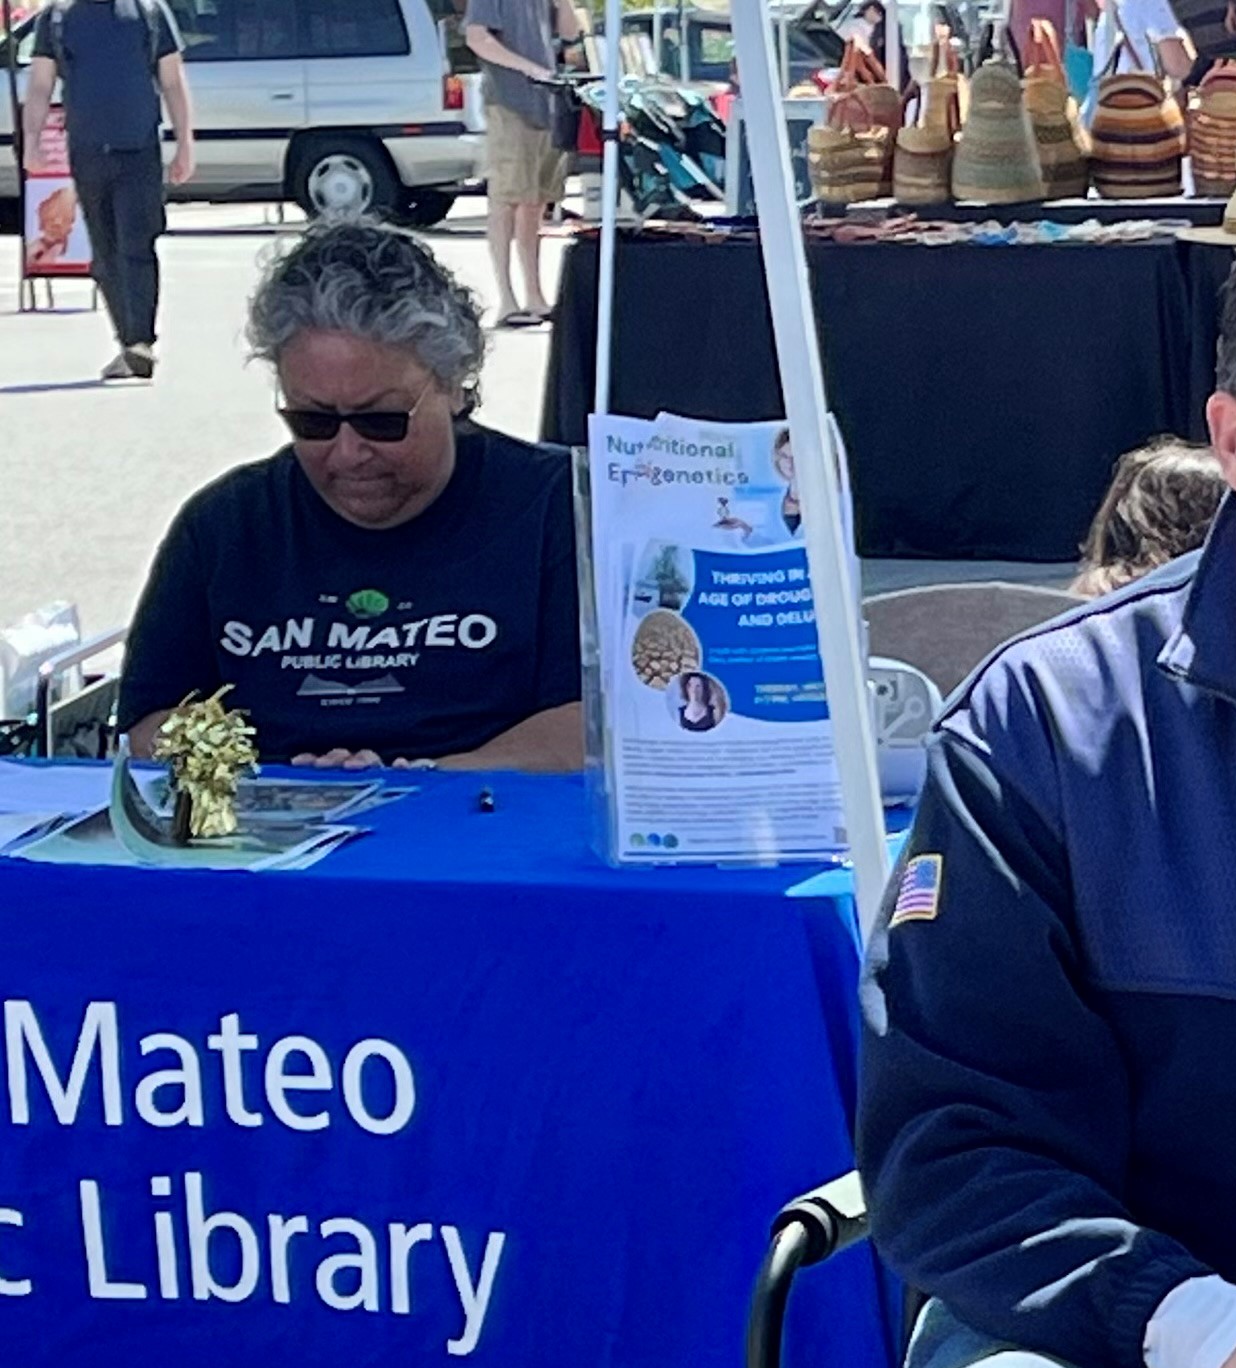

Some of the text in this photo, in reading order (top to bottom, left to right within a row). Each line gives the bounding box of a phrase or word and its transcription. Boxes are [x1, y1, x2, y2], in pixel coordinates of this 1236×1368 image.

[711, 568, 805, 585] THRIVING IN
[698, 587, 813, 606] AGE OF DROUG
[738, 613, 774, 627] AND
[220, 613, 498, 657] SAN MATEO
[281, 652, 420, 669] PUBLIC LIBRARY
[4, 999, 417, 1136] Mateo
[80, 1171, 507, 1356] Library
